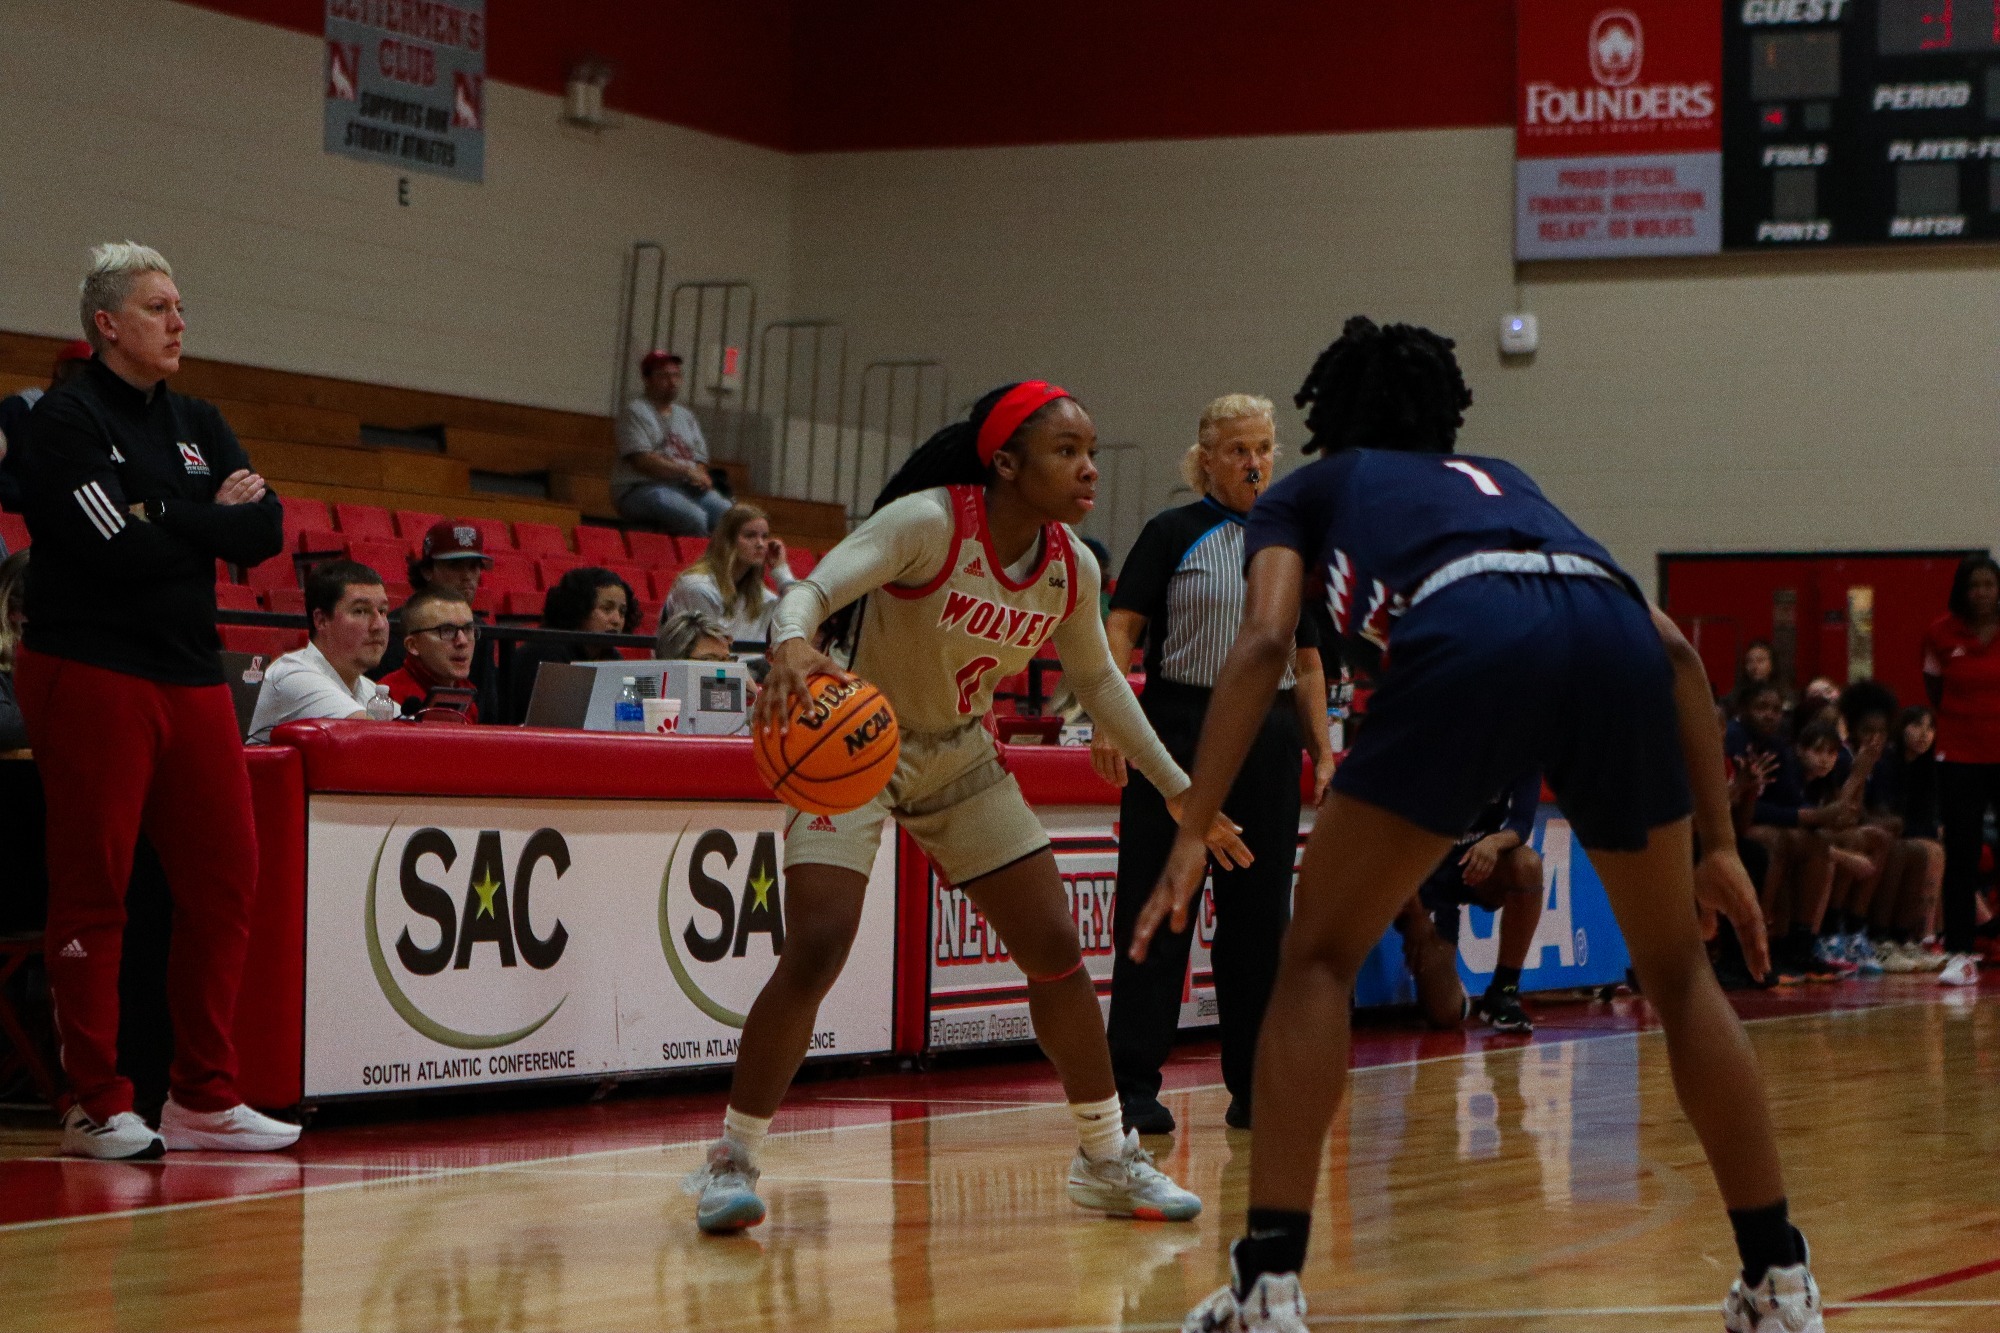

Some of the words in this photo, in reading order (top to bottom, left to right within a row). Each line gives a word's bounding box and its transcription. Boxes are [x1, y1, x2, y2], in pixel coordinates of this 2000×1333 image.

[1740, 0, 1846, 25] GUEST
[378, 38, 440, 87] CLUB
[1525, 82, 1716, 125] FOUNDERS
[1873, 81, 1971, 111] PERIOD
[1763, 143, 1829, 167] FOULS
[398, 177, 410, 207] E
[1757, 218, 1831, 241] POINTS
[1889, 215, 1966, 237] MATCH
[1442, 459, 1504, 496] 1
[1048, 577, 1066, 589] SAC
[955, 655, 1000, 715] 0
[396, 828, 572, 977] SAC
[683, 828, 785, 963] SA
[988, 1014, 1030, 1041] Arena
[662, 1041, 701, 1060] SOUTH
[706, 1038, 741, 1057] ATLAN
[363, 1064, 410, 1085] SOUTH
[417, 1058, 482, 1081] ATLANTIC
[489, 1050, 576, 1075] CONFERENCE
